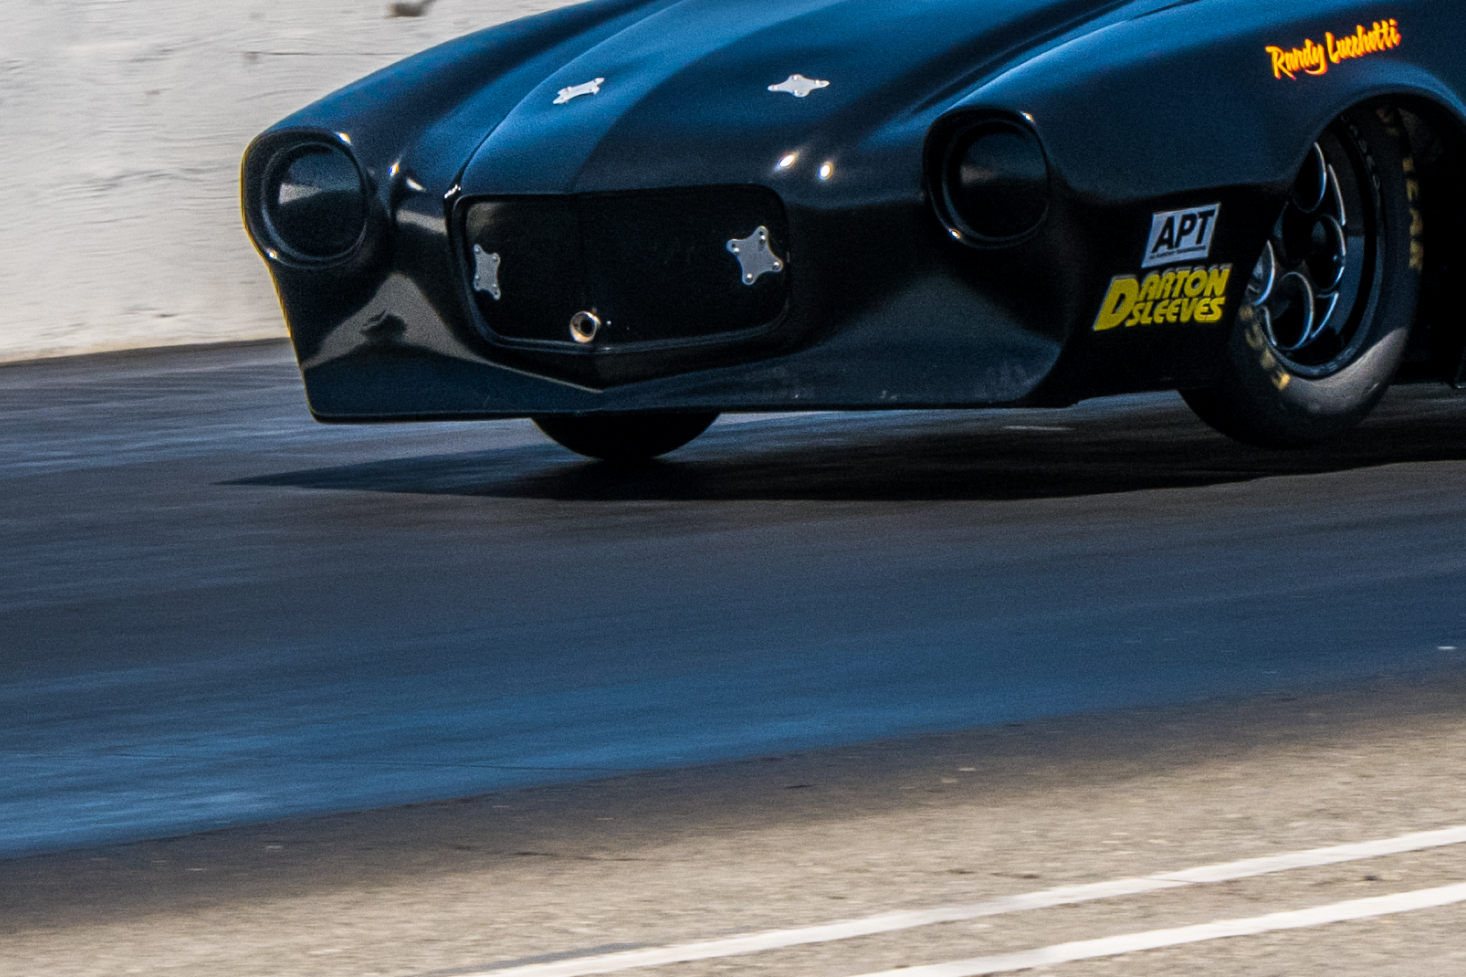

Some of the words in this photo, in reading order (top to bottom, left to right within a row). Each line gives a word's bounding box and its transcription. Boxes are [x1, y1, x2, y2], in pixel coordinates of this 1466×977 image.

[1264, 38, 1328, 82] Randy
[1150, 208, 1217, 254] APT
[1092, 263, 1232, 331] DARTON
[1125, 297, 1227, 327] SLEEVES
